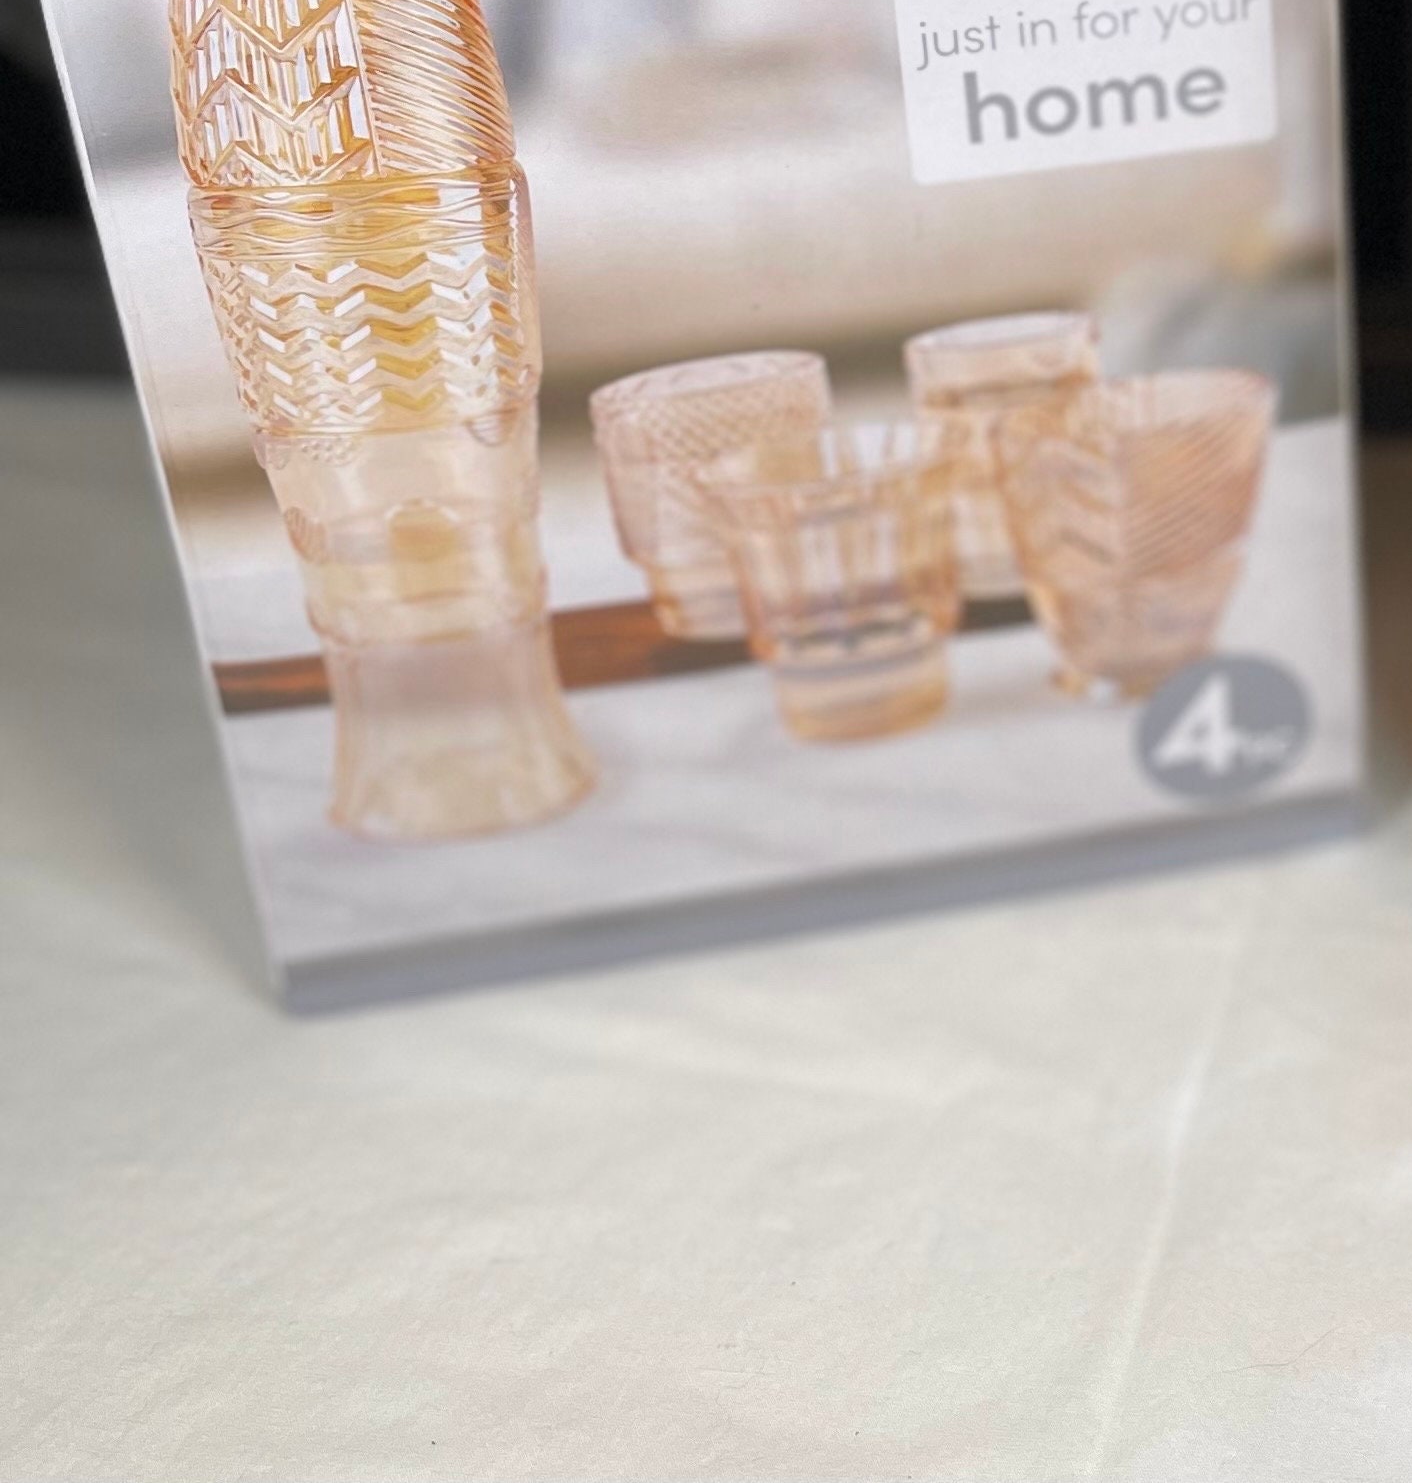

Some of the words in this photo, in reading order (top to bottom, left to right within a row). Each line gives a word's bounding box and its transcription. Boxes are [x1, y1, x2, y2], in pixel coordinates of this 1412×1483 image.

[915, 16, 1002, 72] just
[1015, 10, 1058, 48] in
[1072, 0, 1140, 42] for
[962, 67, 1228, 146] home
